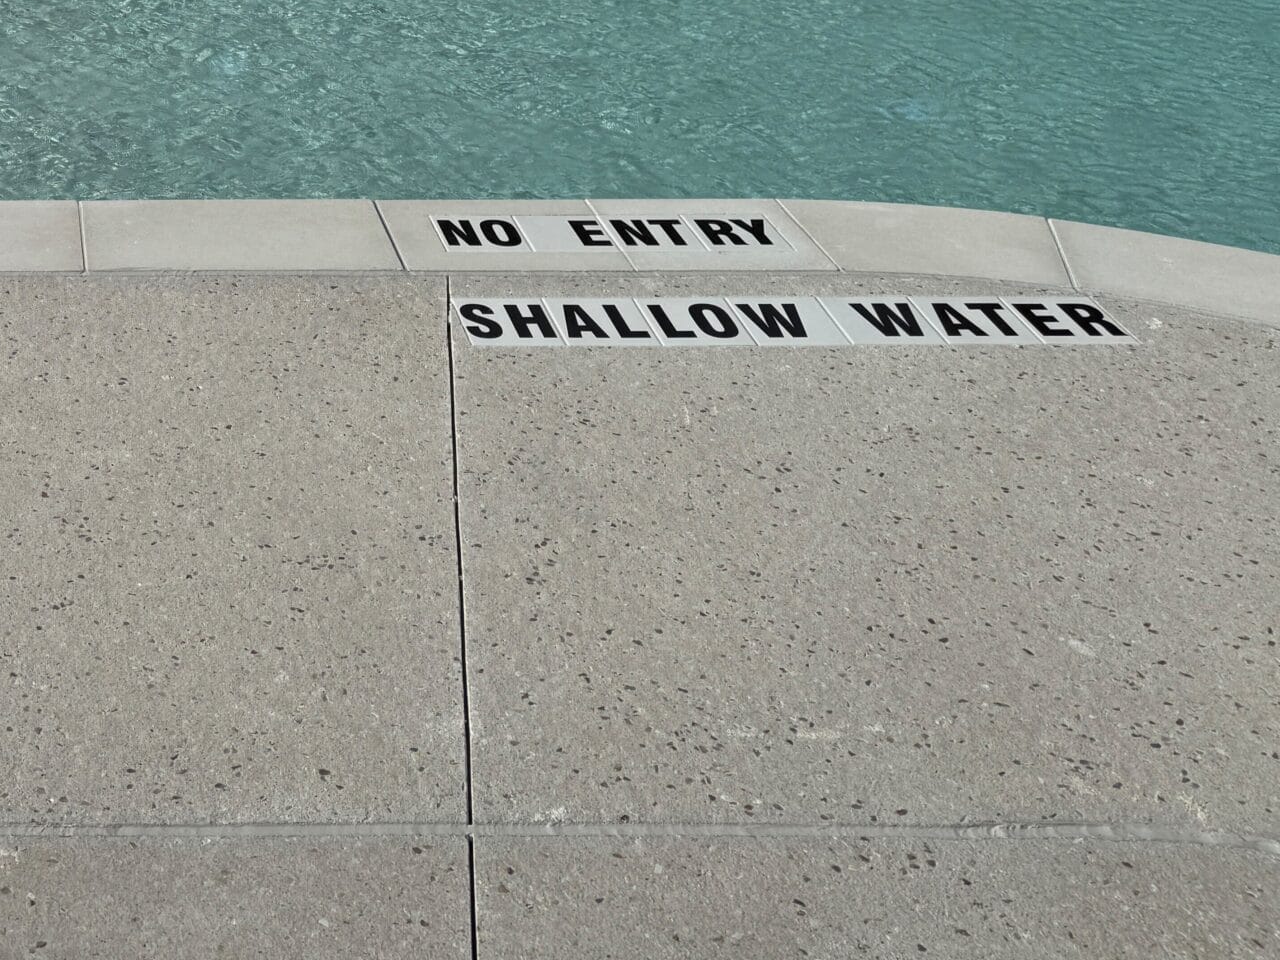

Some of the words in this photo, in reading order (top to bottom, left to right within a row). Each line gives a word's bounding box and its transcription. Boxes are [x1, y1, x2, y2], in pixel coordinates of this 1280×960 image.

[436, 219, 522, 247] NO
[574, 218, 775, 246] ENTRY
[458, 302, 810, 339] SHALLOW
[851, 301, 1135, 337] WATER
